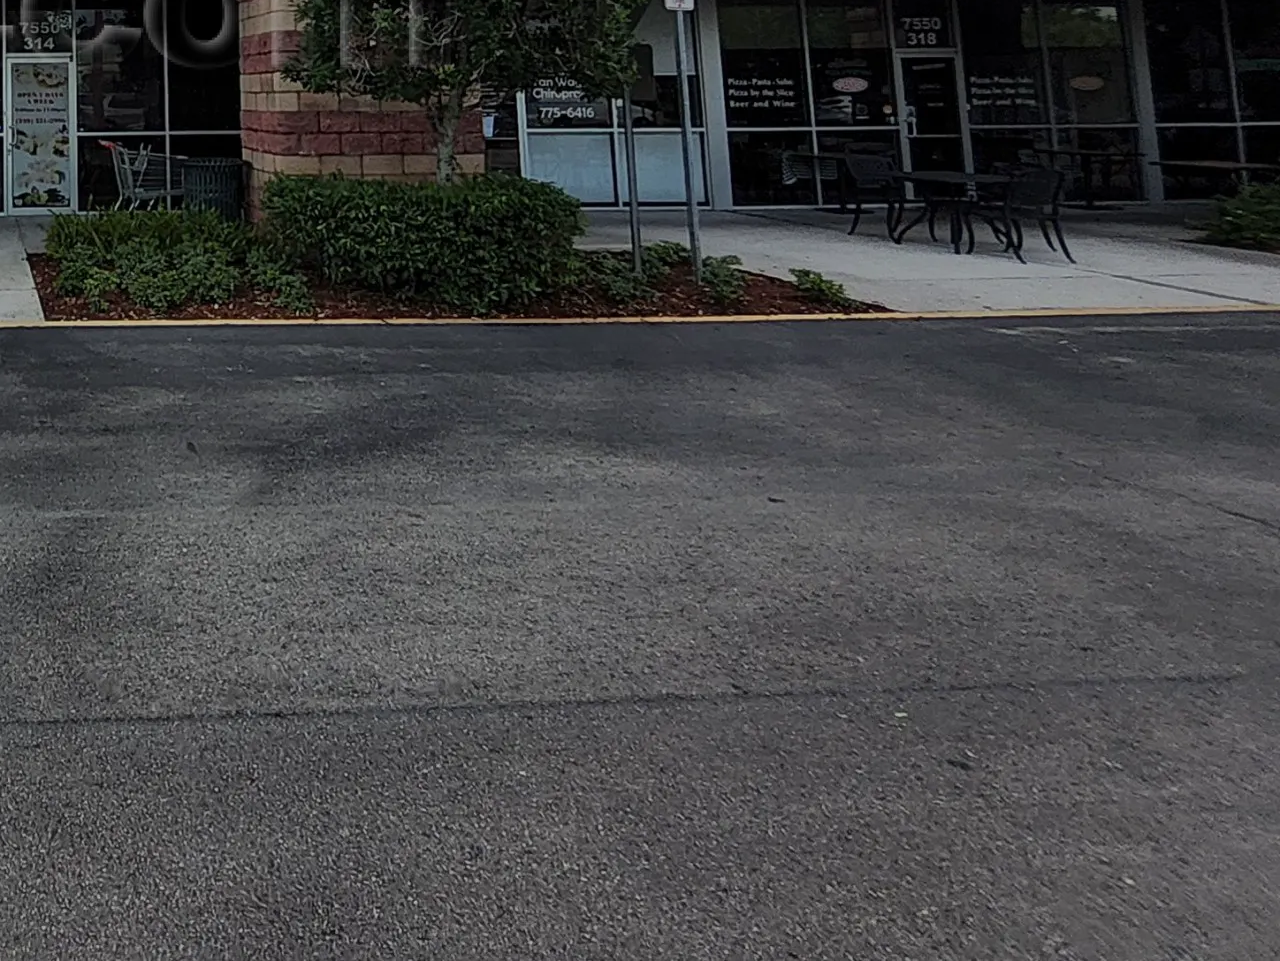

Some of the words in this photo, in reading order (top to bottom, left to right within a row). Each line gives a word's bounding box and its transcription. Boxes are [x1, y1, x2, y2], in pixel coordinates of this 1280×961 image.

[19, 21, 60, 35] 7550
[899, 17, 942, 31] 7550
[23, 37, 55, 51] 314
[907, 32, 937, 46] 318
[533, 78, 554, 87] an
[728, 88, 749, 97] Pizza
[539, 107, 595, 119] 775-6416
